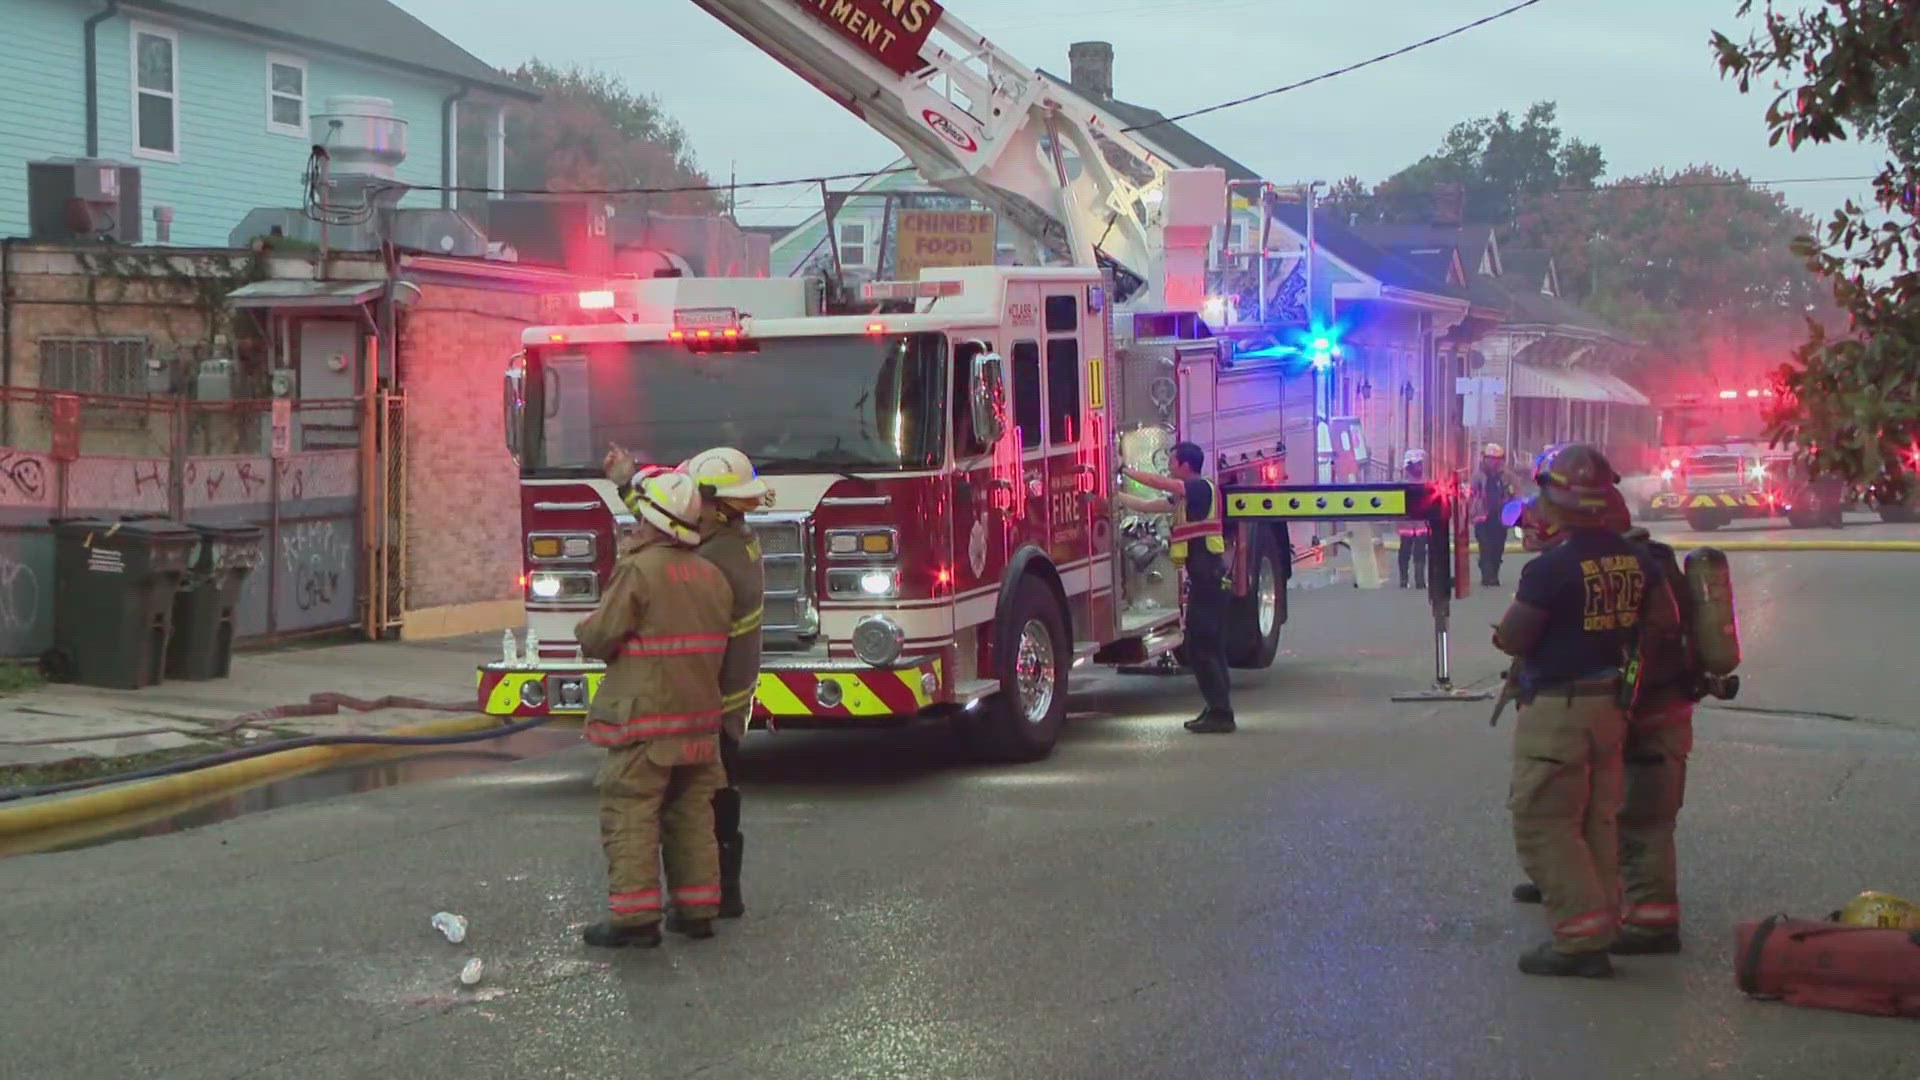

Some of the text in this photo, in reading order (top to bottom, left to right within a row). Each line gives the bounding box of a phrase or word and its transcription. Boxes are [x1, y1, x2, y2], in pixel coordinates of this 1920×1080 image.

[904, 212, 991, 234] CHINESE
[915, 236, 973, 255] FOOD
[1052, 490, 1080, 525] FIRE
[1583, 570, 1645, 616] FIRE
